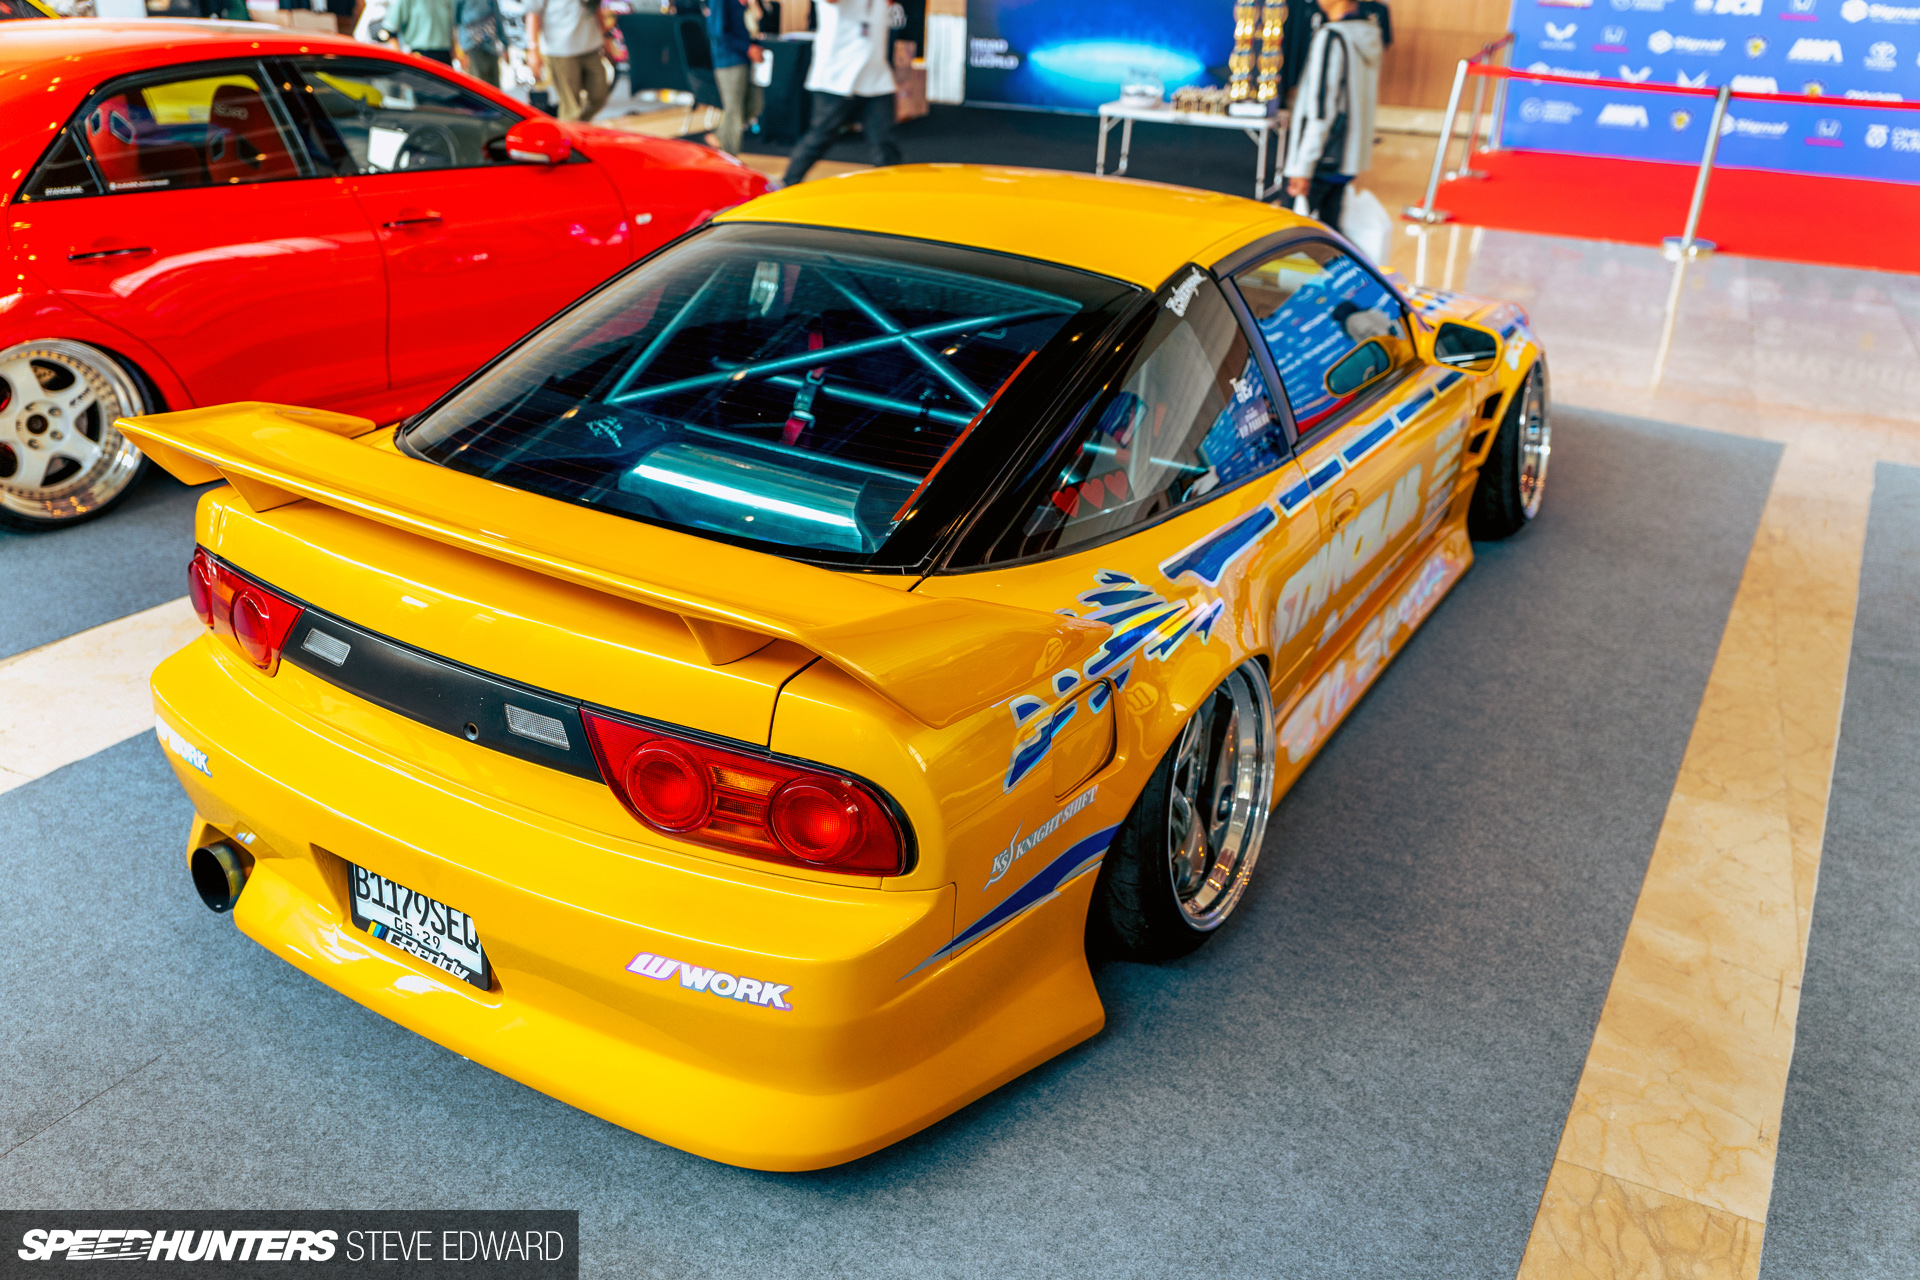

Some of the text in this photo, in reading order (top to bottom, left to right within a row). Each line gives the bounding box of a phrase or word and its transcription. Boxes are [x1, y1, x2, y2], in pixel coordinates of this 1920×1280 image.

[1013, 809, 1064, 861] KNIGHT
[1061, 784, 1098, 824] SHIFT
[680, 963, 790, 1008] WORK
